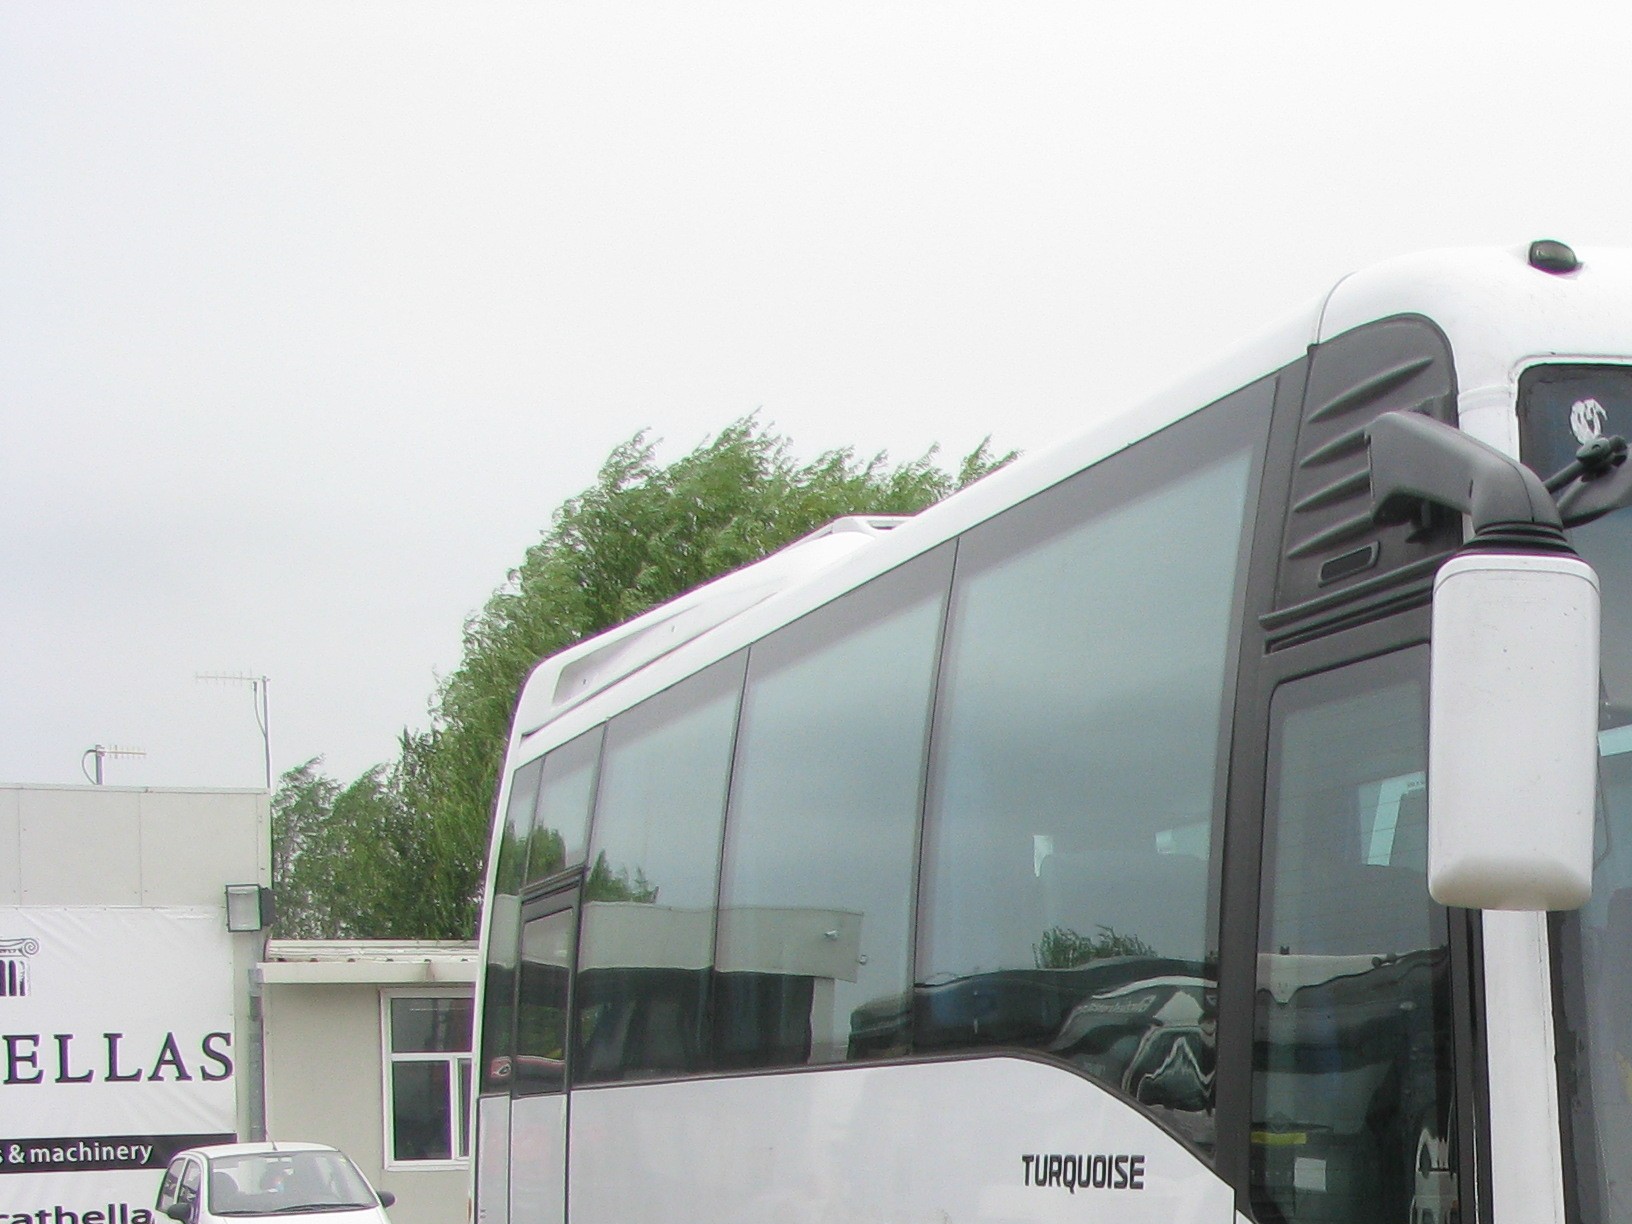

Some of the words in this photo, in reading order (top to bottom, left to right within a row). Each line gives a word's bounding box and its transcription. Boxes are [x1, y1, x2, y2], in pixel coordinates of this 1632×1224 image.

[2, 1032, 234, 1084] ELLAS
[9, 1144, 25, 1163] &
[30, 1142, 153, 1165] machinery
[1022, 1154, 1145, 1193] TURQUOISE
